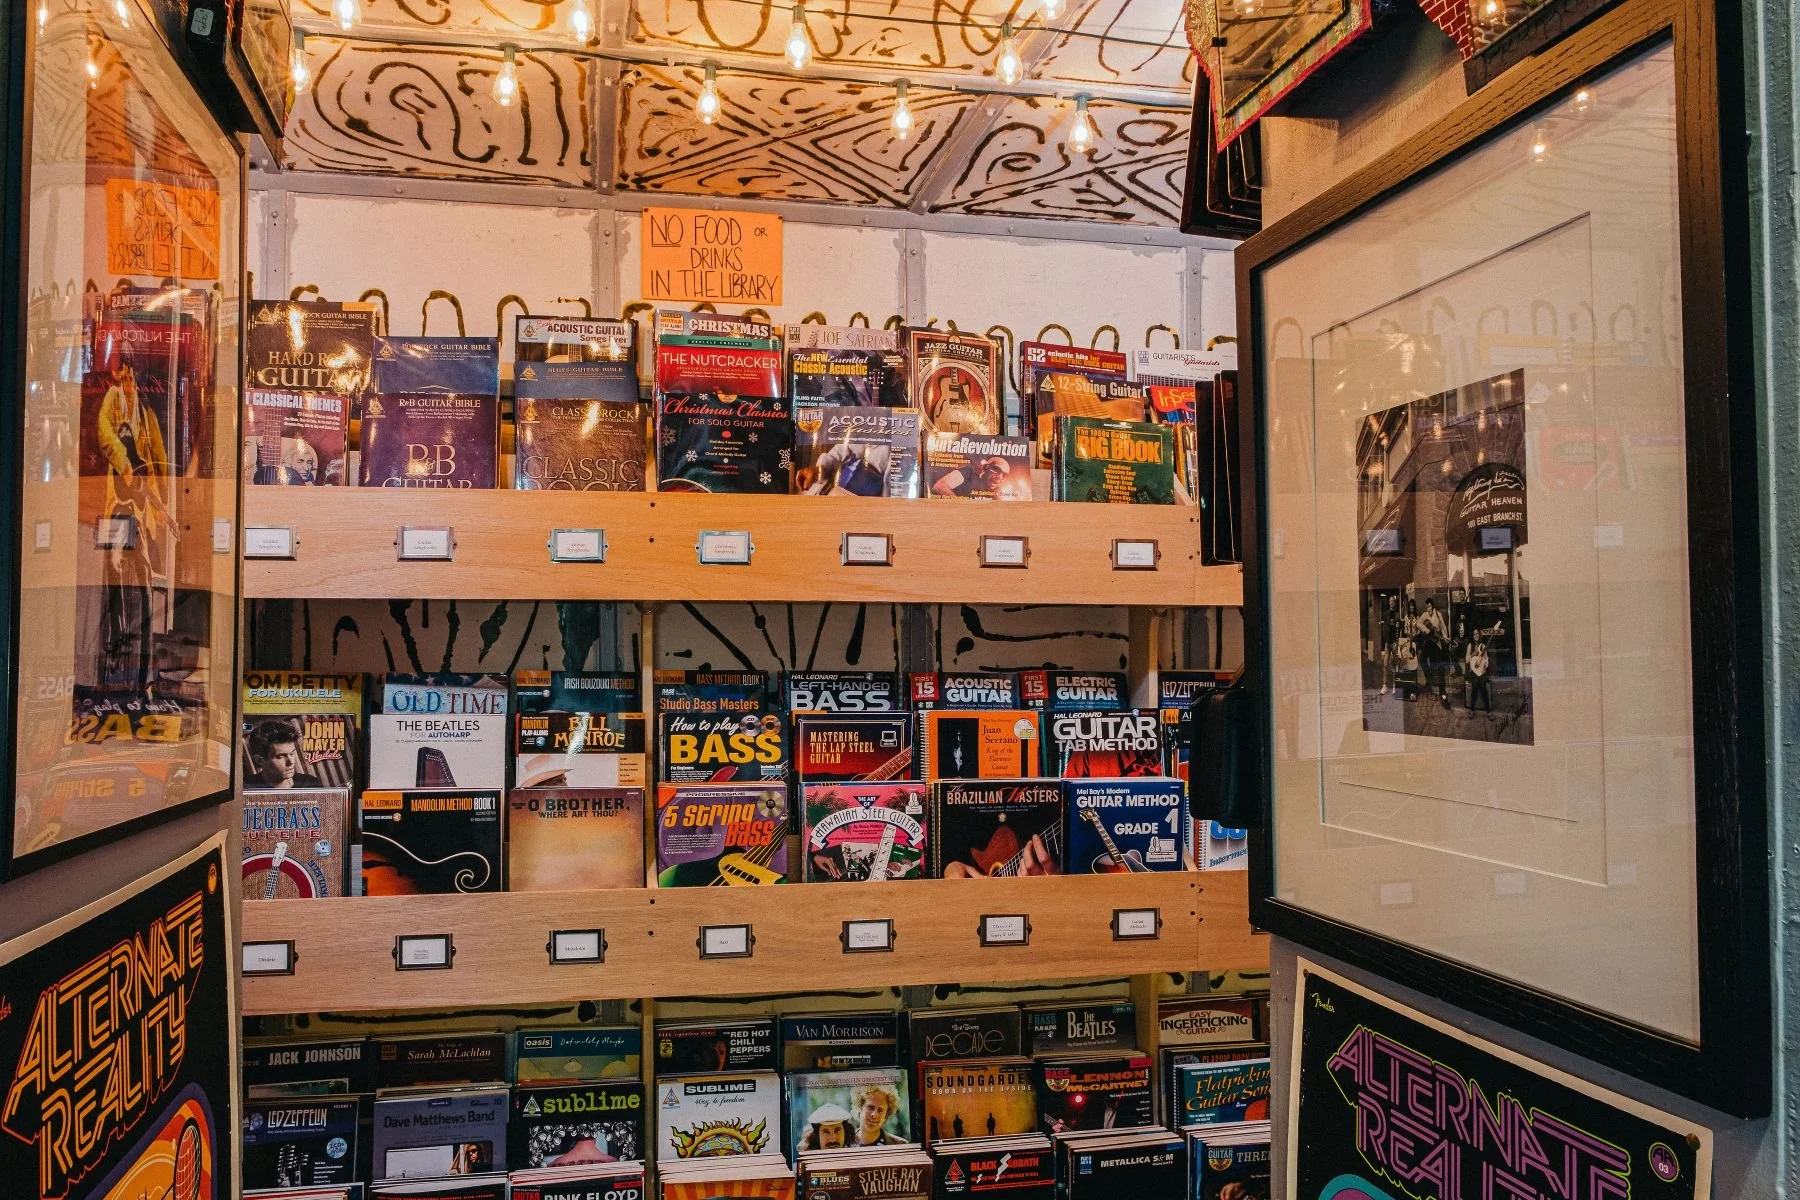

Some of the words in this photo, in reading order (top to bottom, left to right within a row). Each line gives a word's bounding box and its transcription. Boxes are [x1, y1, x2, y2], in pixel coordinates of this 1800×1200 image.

[650, 214, 684, 244] NO
[694, 214, 742, 246] FOOD
[753, 227, 768, 238] OR
[690, 247, 743, 272] DRINKS
[650, 270, 671, 297] IN
[677, 269, 719, 297] THE
[720, 270, 778, 303] LIBRARY
[547, 323, 593, 335] ACOUSTIC
[688, 318, 769, 338] CHRISTMAS
[440, 343, 468, 351] GUITAR
[924, 342, 947, 350] JAZZ
[949, 342, 983, 356] GUITAR
[268, 351, 314, 366] HARD
[661, 352, 688, 365] THE
[690, 353, 778, 369] NUTCRACKER
[810, 352, 829, 363] NEW
[1027, 347, 1046, 363] 52
[793, 361, 827, 375] Classic
[829, 362, 868, 376] Acoustic
[1057, 375, 1108, 398] 12-String
[1109, 382, 1141, 399] Guitar
[253, 393, 304, 411] CLASSICAL
[417, 398, 453, 408] GUITAR
[454, 399, 481, 408] BIBLE
[663, 396, 734, 416] Christmas
[737, 400, 789, 419] Classics
[601, 408, 634, 419] ROCK
[688, 417, 705, 425] FOR
[707, 418, 731, 427] SOLO
[733, 420, 765, 428] GUITAR
[828, 415, 915, 429] ACOUSTIC
[1077, 435, 1109, 459] BIG
[1111, 436, 1161, 462] BOOK
[405, 443, 457, 477] R&B
[522, 455, 639, 483] CLASSIC
[1491, 496, 1523, 507] HEAVEN
[1476, 514, 1492, 526] EAST
[1492, 512, 1515, 522] BRANCH
[287, 674, 358, 690] PETTY
[564, 677, 580, 689] IRISH
[580, 677, 610, 689] BOUZOUKI
[791, 681, 890, 691] LEFT-HANDED
[915, 681, 935, 695] 15
[944, 677, 1012, 690] ACOUSTIC
[1025, 680, 1044, 693] 15
[1055, 676, 1116, 688] ELECTRIC
[249, 688, 277, 698] FOR
[279, 688, 342, 698] UKULELE
[946, 689, 1012, 703] GUITAR
[1056, 687, 1118, 701] GUITAR
[392, 691, 441, 712] OLD
[446, 691, 505, 714] TIME
[660, 697, 691, 710] Studio
[693, 697, 717, 710] Bass
[719, 697, 760, 710] Masters
[791, 690, 891, 711] BASS
[304, 722, 345, 739] JOHN
[396, 720, 422, 731] THE
[425, 720, 480, 731] BEATLES
[670, 716, 696, 732] How
[698, 719, 711, 731] to
[711, 716, 740, 736] play
[983, 725, 1001, 735] Juan
[1053, 716, 1157, 739] GUITAR
[810, 731, 859, 742] MASTERING
[985, 736, 1018, 744] Serrano
[303, 739, 345, 751] MAYER
[670, 734, 782, 764] BASS
[810, 742, 827, 753] THE
[830, 742, 846, 753] LAP
[849, 742, 874, 753] STEEL
[1055, 739, 1087, 752] TAB
[1089, 737, 1158, 751] METHOD
[810, 753, 841, 764] GUITAR
[947, 790, 1003, 805] BRAZILIAN
[1089, 787, 1105, 795] Bay's
[411, 798, 445, 812] MANDOLIN
[446, 798, 473, 811] METHOD
[473, 797, 492, 810] BOOK
[492, 797, 496, 809] 1
[528, 799, 540, 812] O
[545, 797, 630, 811] BROTHER,
[1076, 795, 1123, 808] GUITAR
[1125, 794, 1180, 807] METHOD
[592, 810, 619, 818] THOU?
[664, 805, 680, 827] 5
[1165, 808, 1179, 834] 1
[815, 808, 858, 838] HAWAIIAN
[861, 807, 886, 820] STEEL
[889, 811, 921, 836] GUITAR
[1114, 822, 1159, 835] GRADE
[3, 892, 203, 1124] ALTERNATE
[1311, 993, 1335, 1013] Fender
[751, 1029, 771, 1037] HOT
[795, 1024, 818, 1038] VAN
[822, 1024, 884, 1037] MORRISON
[1186, 1027, 1217, 1035] GUITAR
[526, 1038, 550, 1046] oasis
[730, 1045, 771, 1053] PEPPERS
[268, 1051, 300, 1066] JACK
[304, 1047, 361, 1063] JOHNSON
[407, 1050, 435, 1060] Sarah
[439, 1047, 491, 1059] McLachlan
[1069, 1070, 1145, 1083] LENNON
[40, 984, 185, 1197] REALITY
[685, 1083, 755, 1093] SUBLIME
[1066, 1079, 1149, 1092] McCARTNEY
[543, 1091, 640, 1114] sublime
[384, 1116, 410, 1128] Dave
[412, 1113, 465, 1127] Matthews
[467, 1110, 495, 1121] Band
[1328, 1029, 1628, 1200] ALTERNATE
[1208, 1149, 1233, 1159] GUITAR
[971, 1161, 997, 1171] BLACK
[1100, 1156, 1150, 1168] METALLICA
[1657, 1161, 1670, 1174] 03
[858, 1168, 898, 1184] STEVIE
[901, 1168, 923, 1180] RAY
[861, 1178, 920, 1195] VAUGHAN
